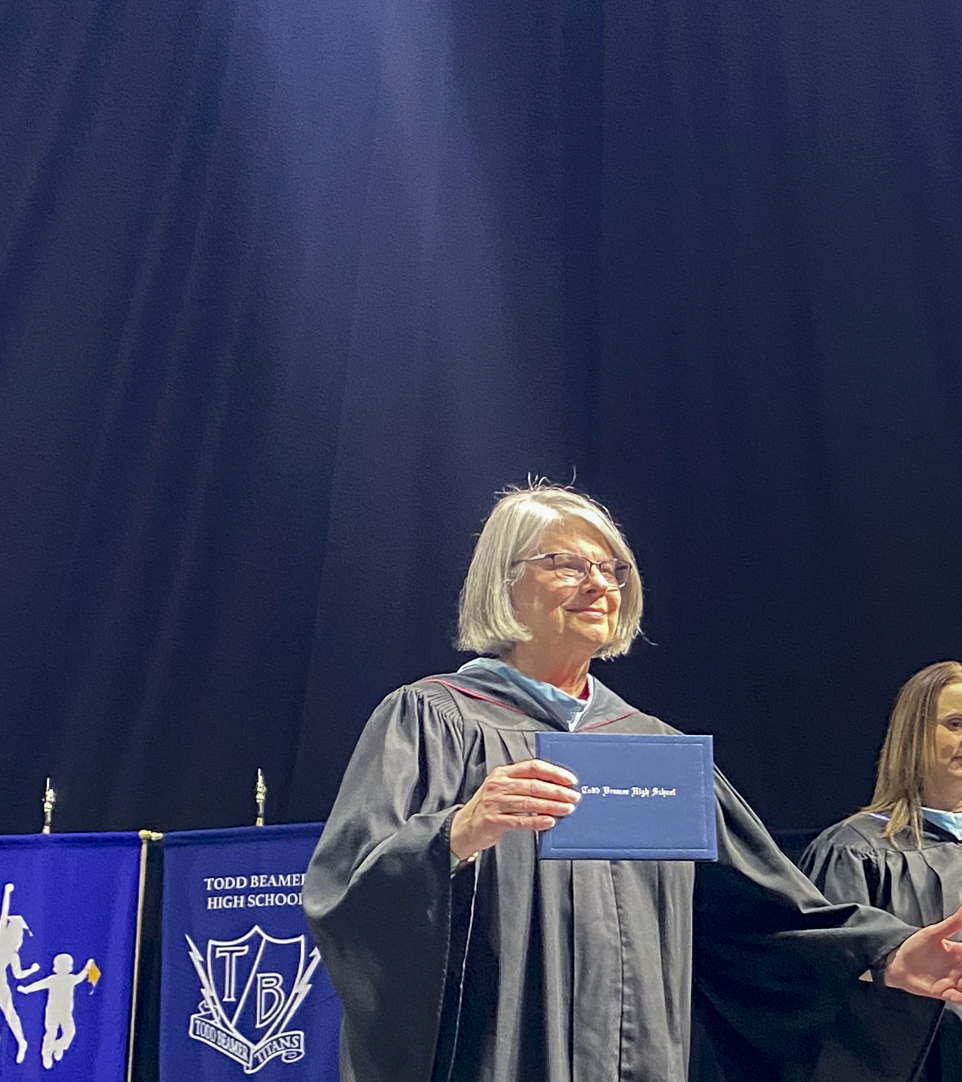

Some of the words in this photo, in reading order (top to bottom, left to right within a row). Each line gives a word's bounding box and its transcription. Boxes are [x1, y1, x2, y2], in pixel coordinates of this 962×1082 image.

[203, 876, 247, 890] TODD
[207, 895, 245, 910] HIGH
[253, 1035, 300, 1063] TITANS
